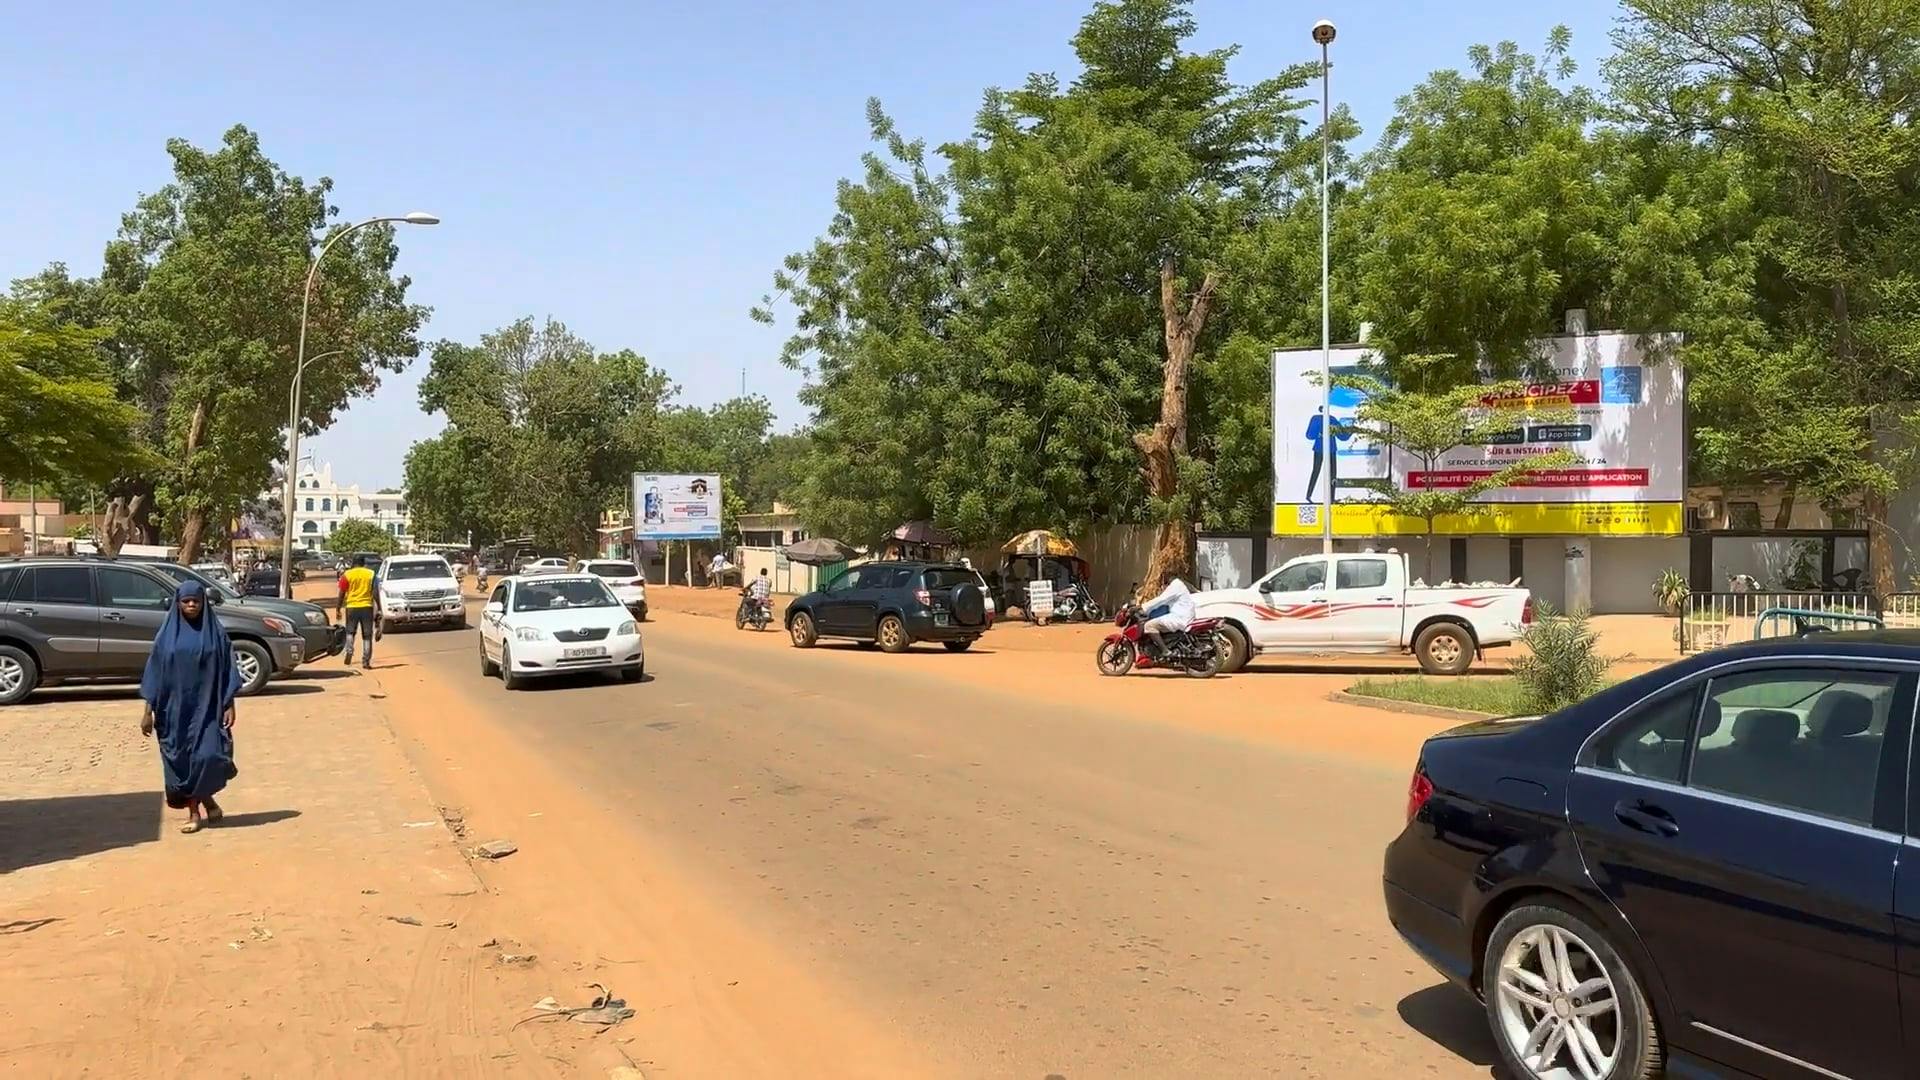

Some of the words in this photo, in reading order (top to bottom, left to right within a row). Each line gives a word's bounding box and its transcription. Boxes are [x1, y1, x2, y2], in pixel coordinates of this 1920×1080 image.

[1547, 397, 1567, 405] TEST
[1548, 430, 1563, 440] App
[1563, 430, 1582, 439] Store
[1487, 446, 1504, 456] SÛR
[1504, 447, 1512, 456] &
[1569, 474, 1583, 482] DE
[1583, 473, 1642, 481] L'APPLICATION
